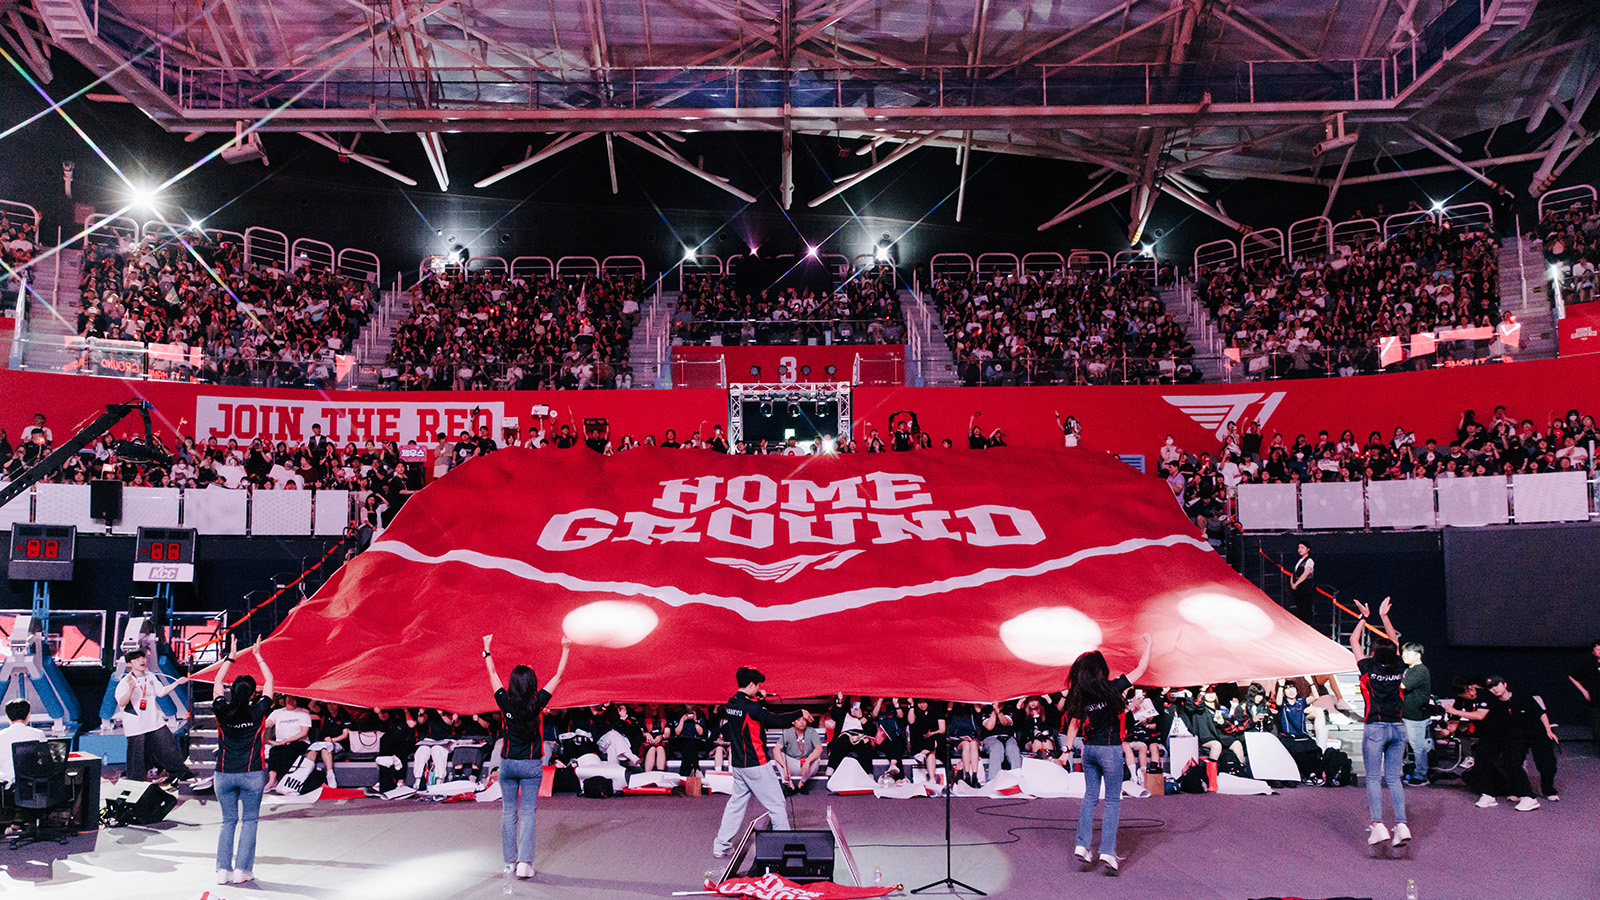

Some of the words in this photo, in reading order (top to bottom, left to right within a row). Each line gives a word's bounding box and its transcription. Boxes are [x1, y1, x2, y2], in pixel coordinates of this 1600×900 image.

[209, 403, 304, 441] JOIN
[321, 408, 400, 442] THE
[652, 471, 932, 513] HOME
[536, 504, 1046, 552] GROUND
[150, 567, 177, 579] KCC
[284, 776, 304, 793] NIK
